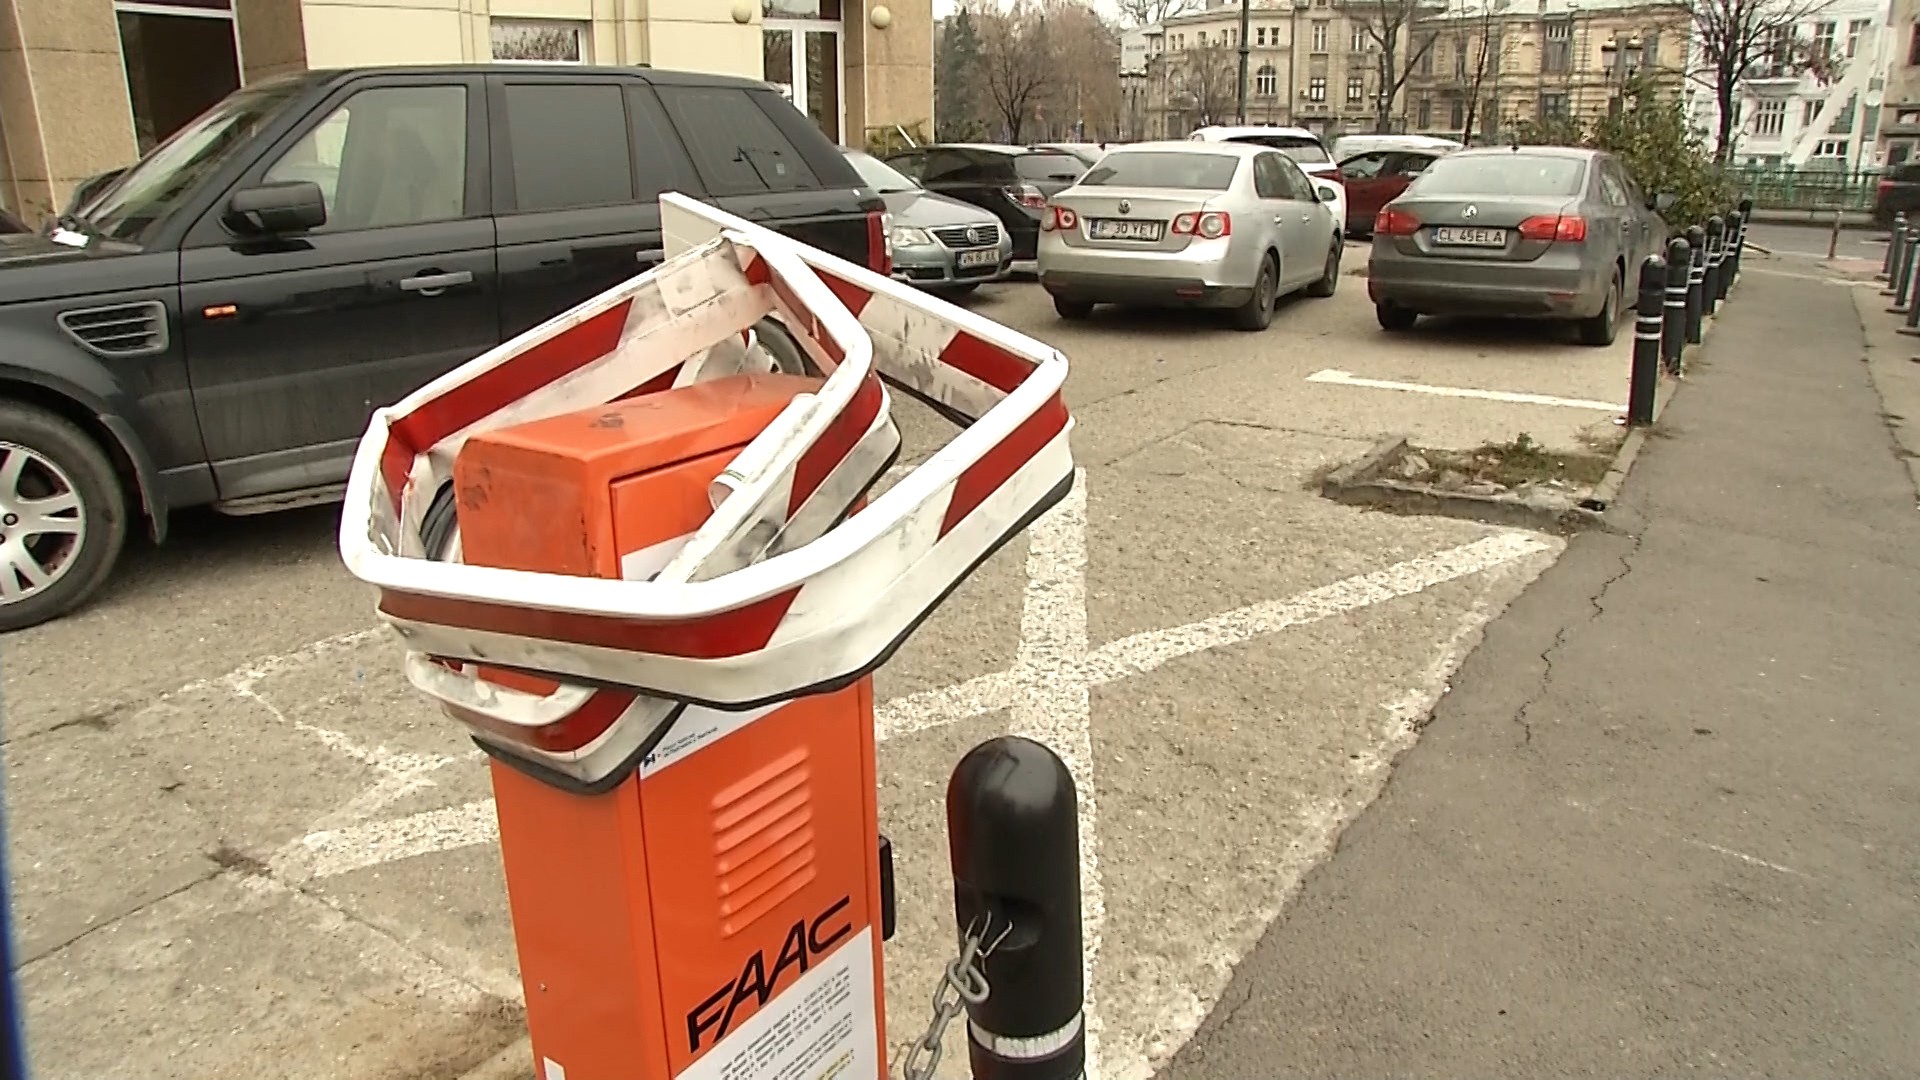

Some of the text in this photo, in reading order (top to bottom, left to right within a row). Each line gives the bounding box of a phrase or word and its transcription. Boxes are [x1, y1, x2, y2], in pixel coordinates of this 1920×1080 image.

[1115, 223, 1128, 234] 30
[1439, 229, 1454, 241] CL
[686, 895, 852, 1053] FAAC
